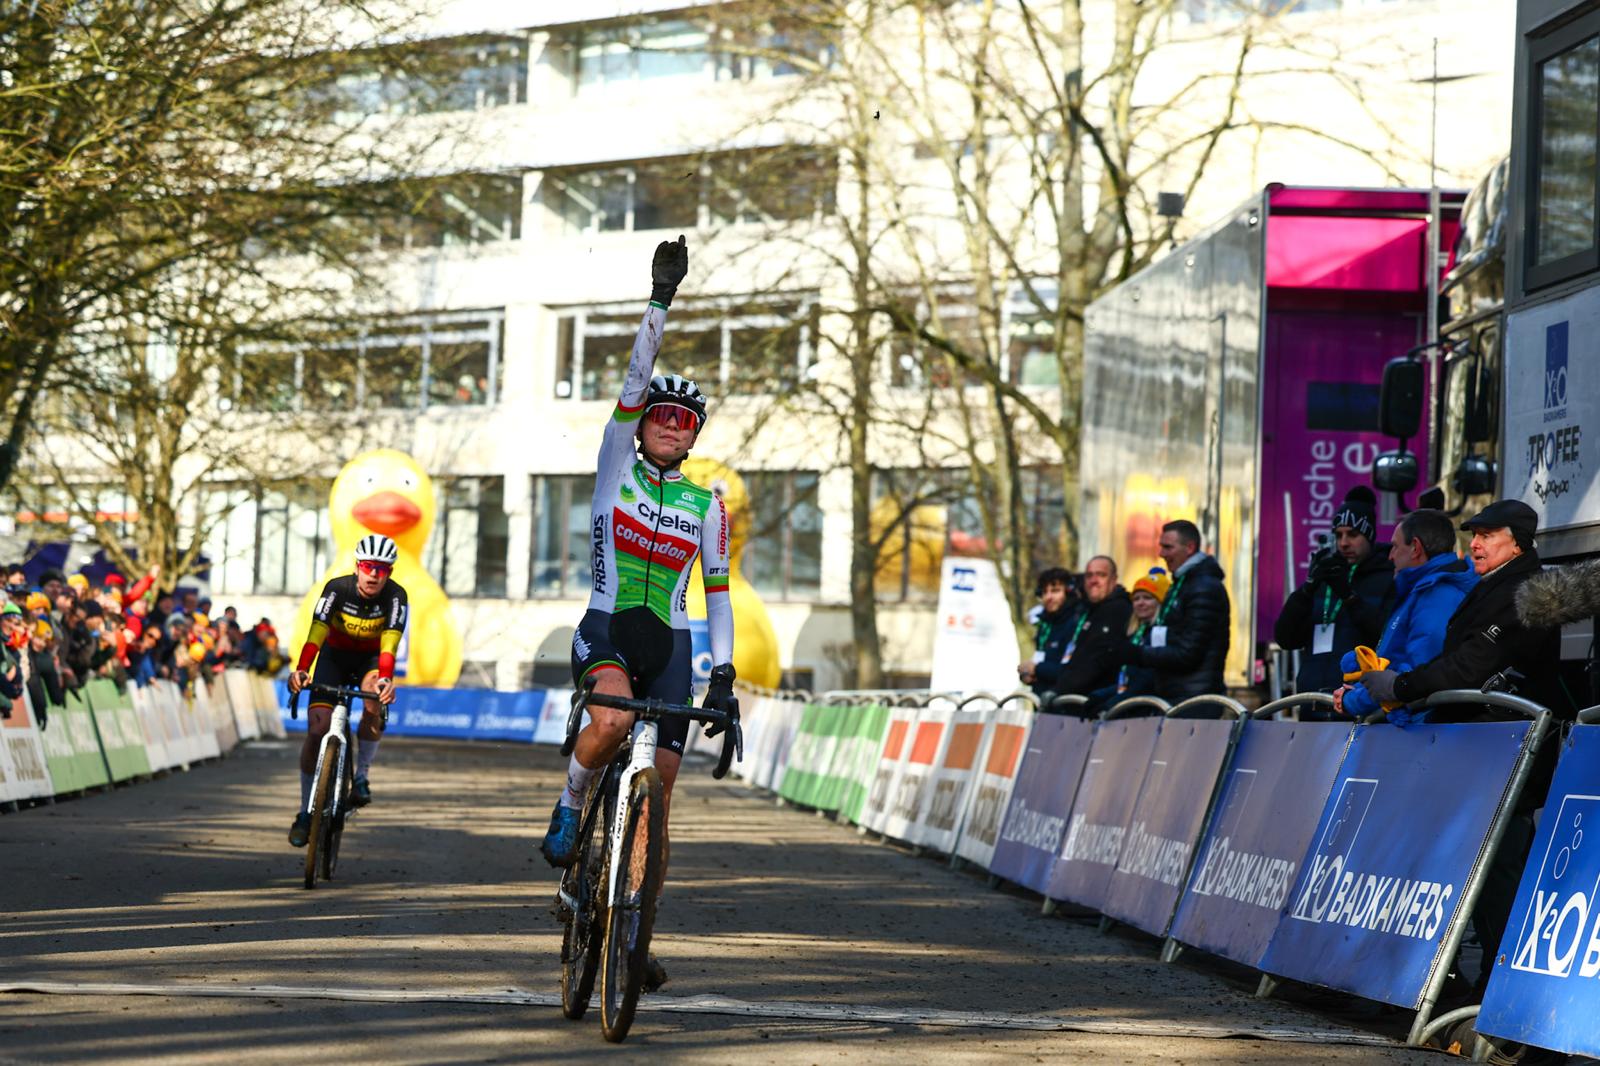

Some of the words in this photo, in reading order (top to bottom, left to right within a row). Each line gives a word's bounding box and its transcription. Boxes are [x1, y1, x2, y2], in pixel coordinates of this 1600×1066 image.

[1528, 425, 1580, 474] TROFEE
[593, 513, 606, 595] FRISTADS
[615, 523, 687, 561] corendon
[1214, 850, 1296, 911] BADKAMERS
[1326, 871, 1453, 941] BADKAMERS
